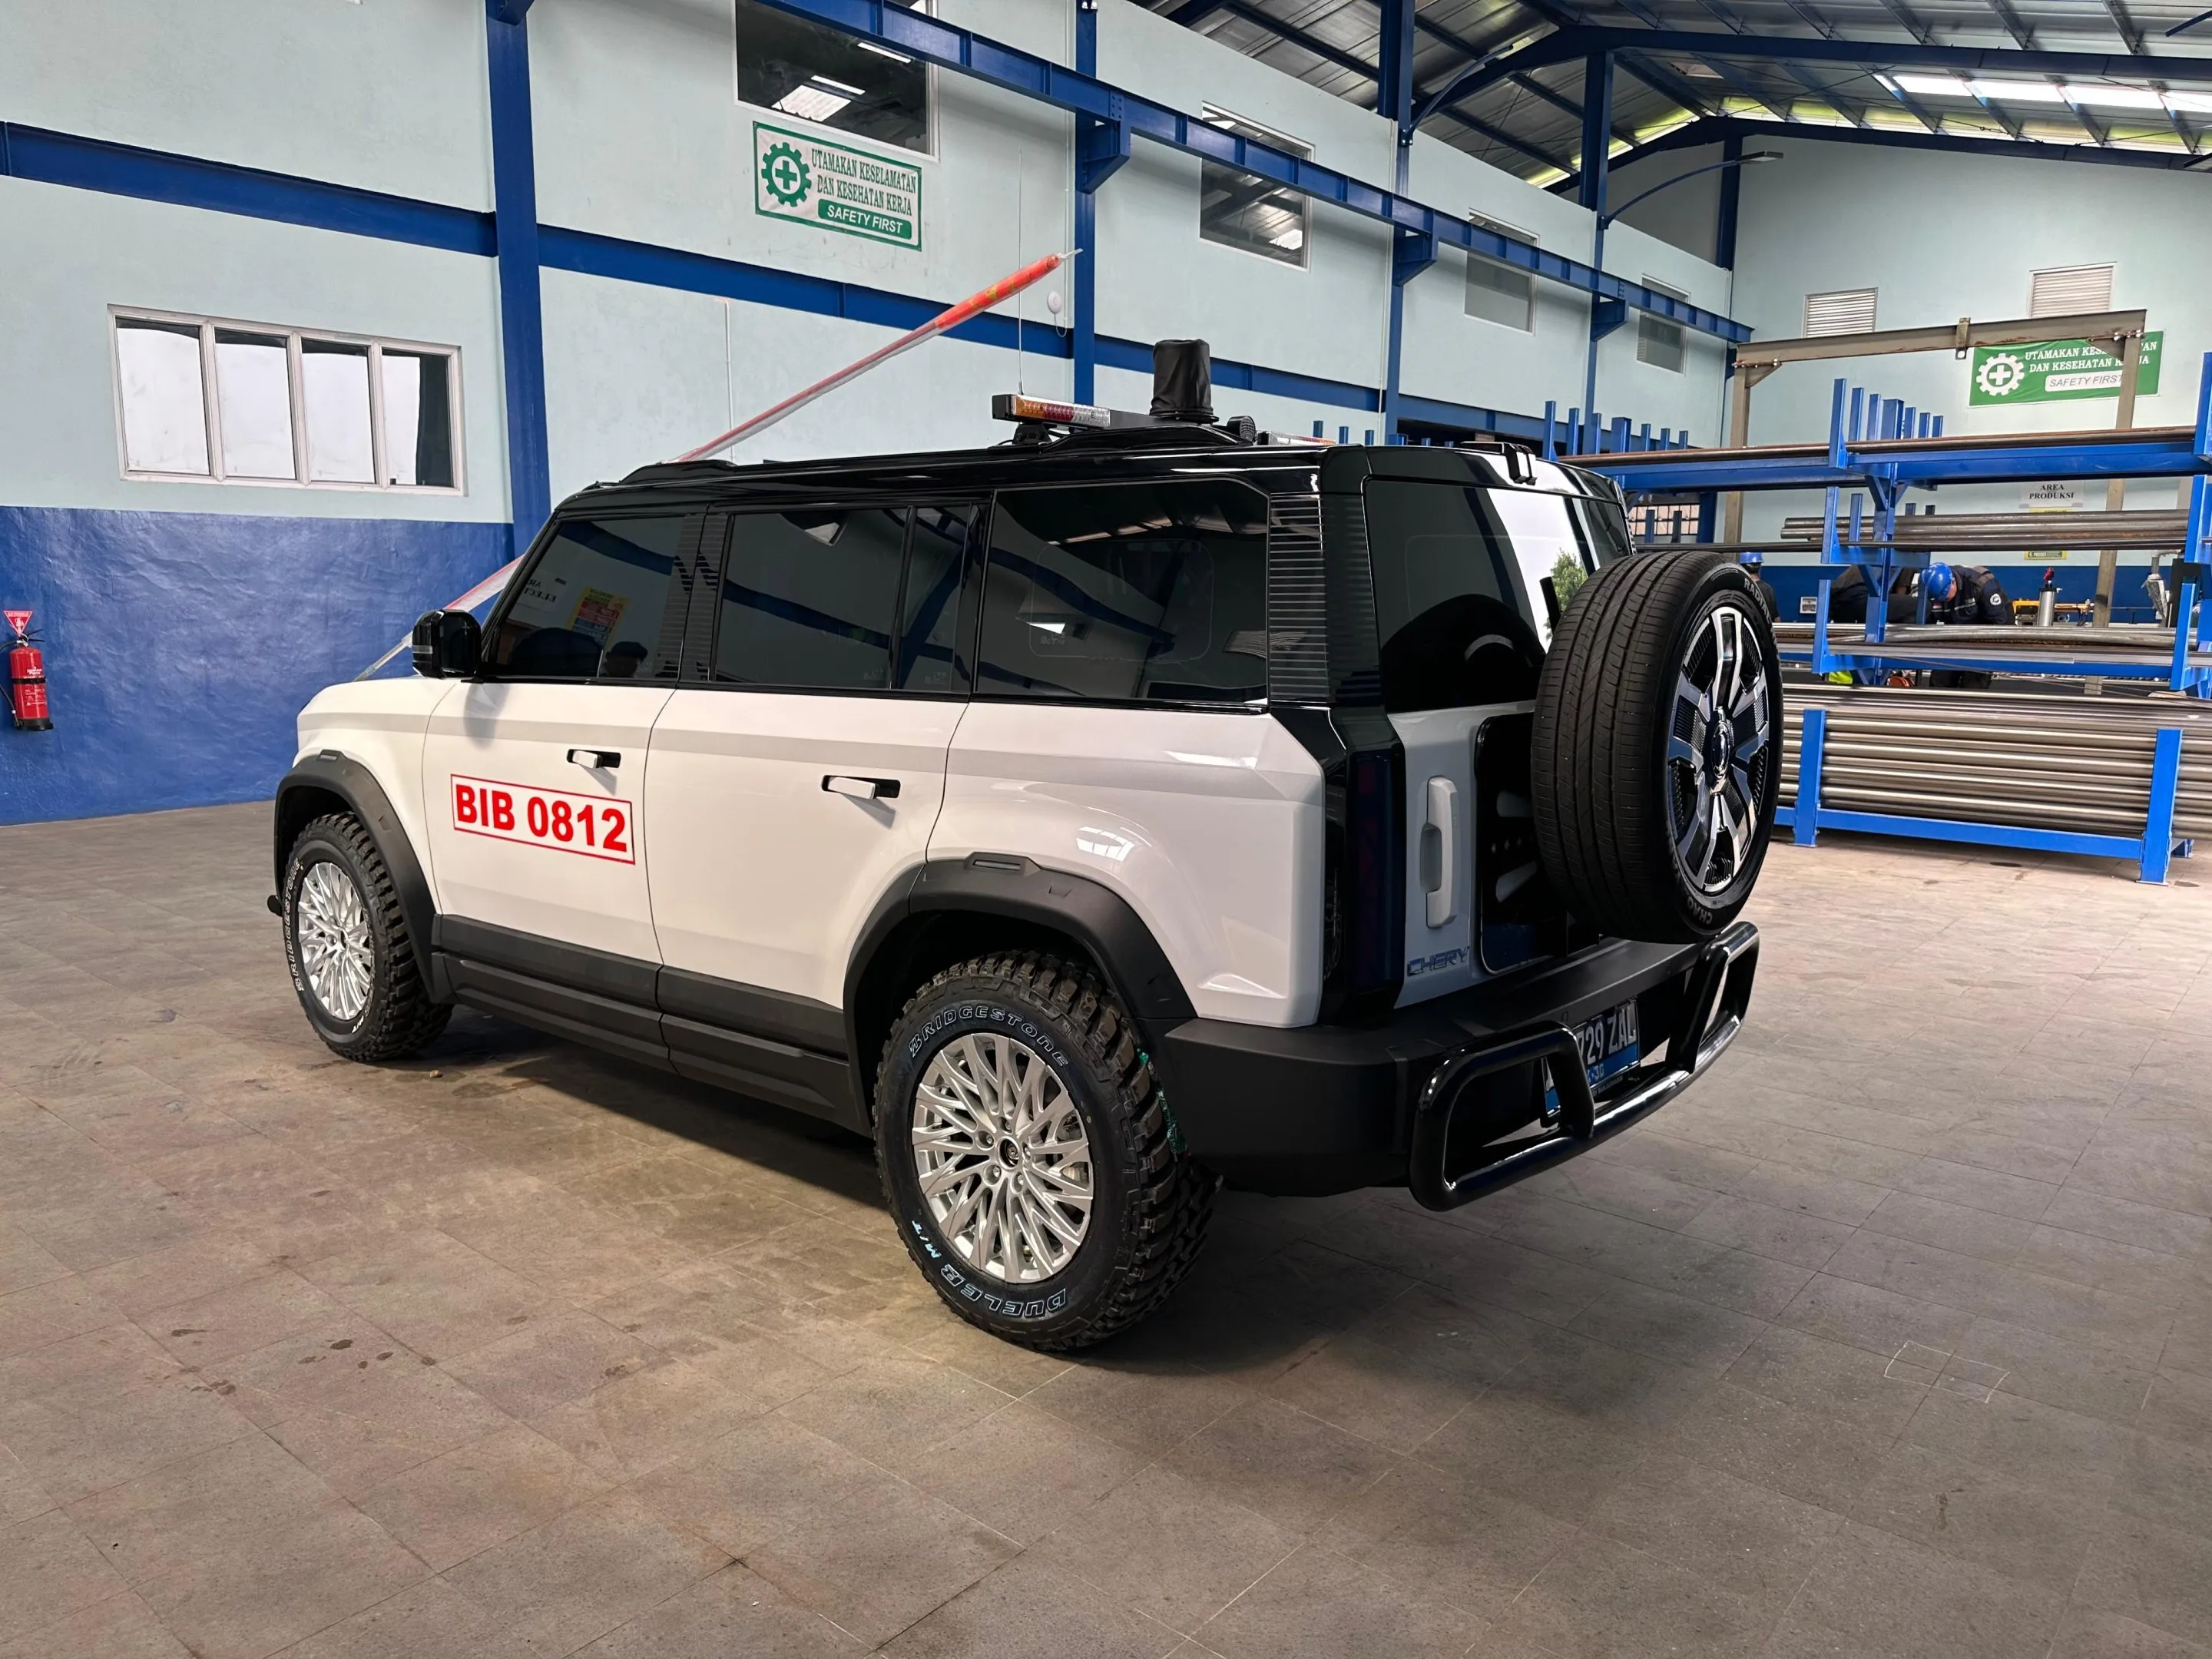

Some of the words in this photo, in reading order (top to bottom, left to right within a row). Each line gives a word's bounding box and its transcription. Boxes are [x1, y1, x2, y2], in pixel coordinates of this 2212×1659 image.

[811, 148, 857, 177] UTAMAKAN
[859, 161, 916, 194] KESELAMATAN
[817, 174, 835, 195] DAN
[836, 179, 884, 208] KESEHATAN
[886, 193, 912, 216] KERJA
[827, 205, 871, 226] SAFETY
[872, 216, 903, 234] FIRST
[2025, 347, 2079, 360] UTAMAKAN
[2029, 361, 2050, 373] DAN
[2051, 358, 2114, 372] KESEHATAN
[2048, 376, 2092, 388] SAFETY
[1743, 578, 1773, 625] RADIAL
[455, 783, 515, 831] BIB
[527, 796, 628, 853] 0812
[1407, 945, 1469, 976] CHERY
[909, 1005, 1069, 1068] BRIDGESTONE
[1607, 1005, 1637, 1055] ZAL
[912, 1219, 942, 1259] M/T
[939, 1263, 1067, 1320] DUELER
